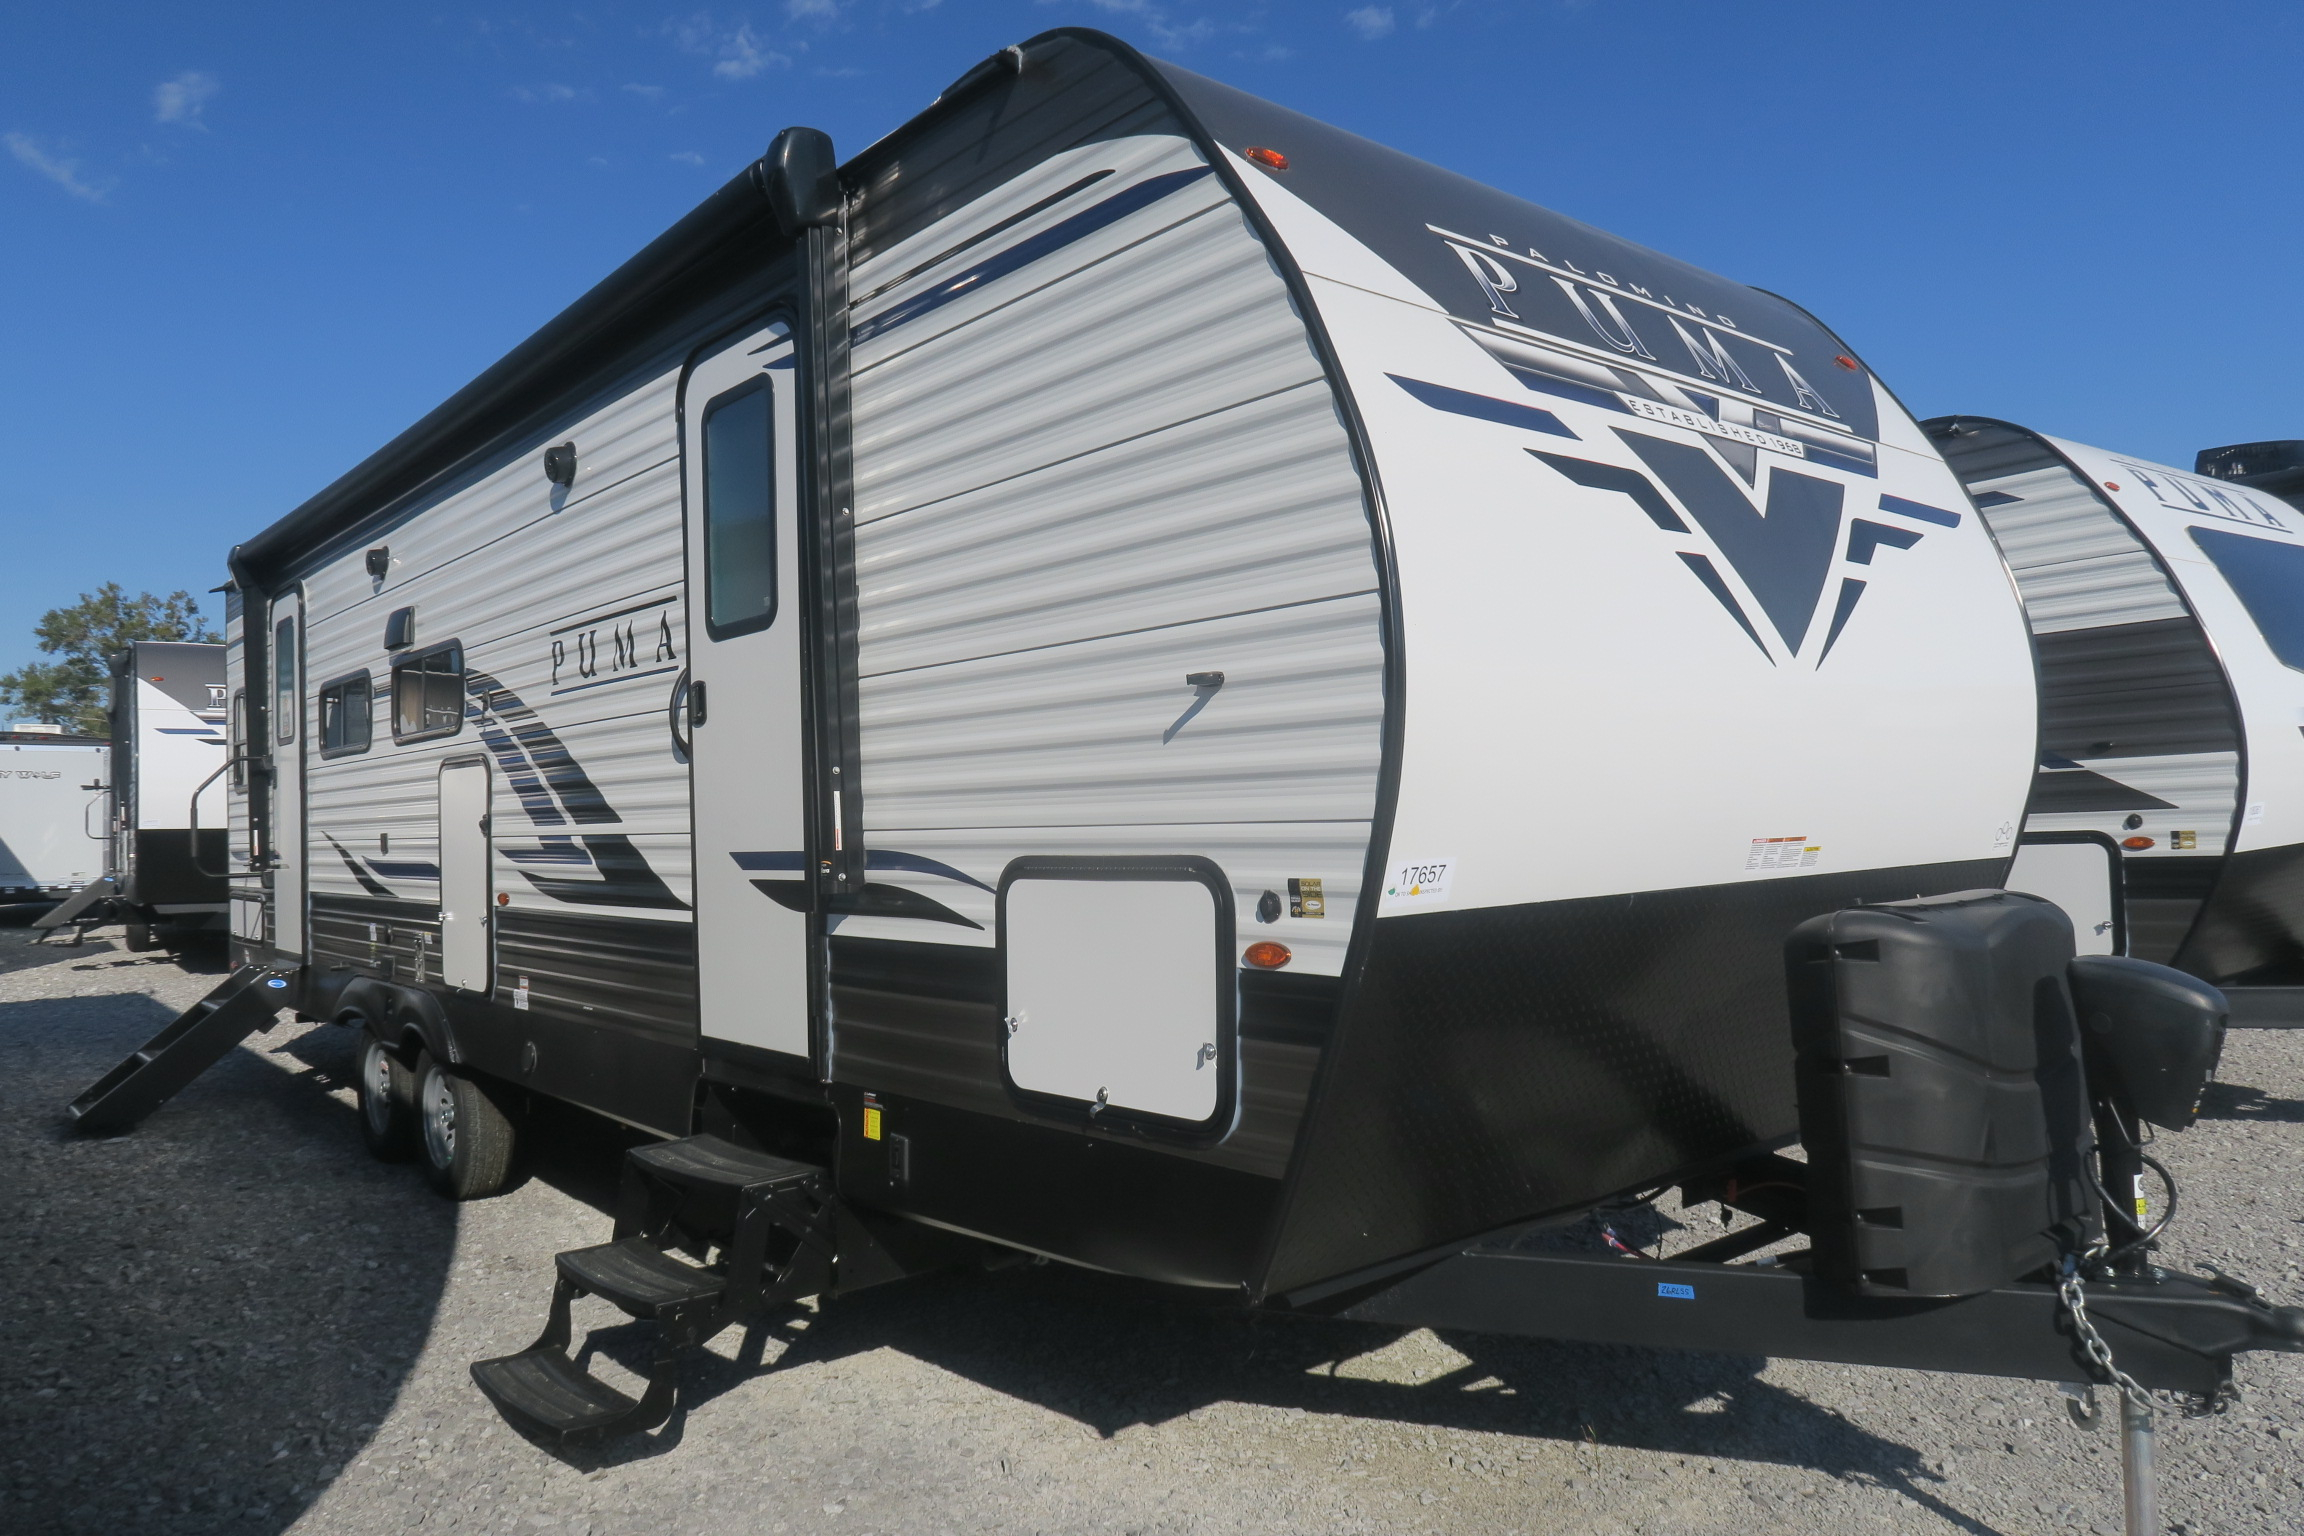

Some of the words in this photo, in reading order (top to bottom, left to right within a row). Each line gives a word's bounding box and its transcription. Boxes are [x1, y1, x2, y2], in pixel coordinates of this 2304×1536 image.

[1489, 233, 1737, 329] PALOMINO
[1444, 239, 1841, 419] PUMA
[1628, 399, 1767, 443] ESTABLISHED
[1769, 437, 1802, 455] 1968
[2119, 464, 2287, 528] PUMA
[551, 609, 677, 686] PUMA
[1401, 864, 1447, 886] 17657
